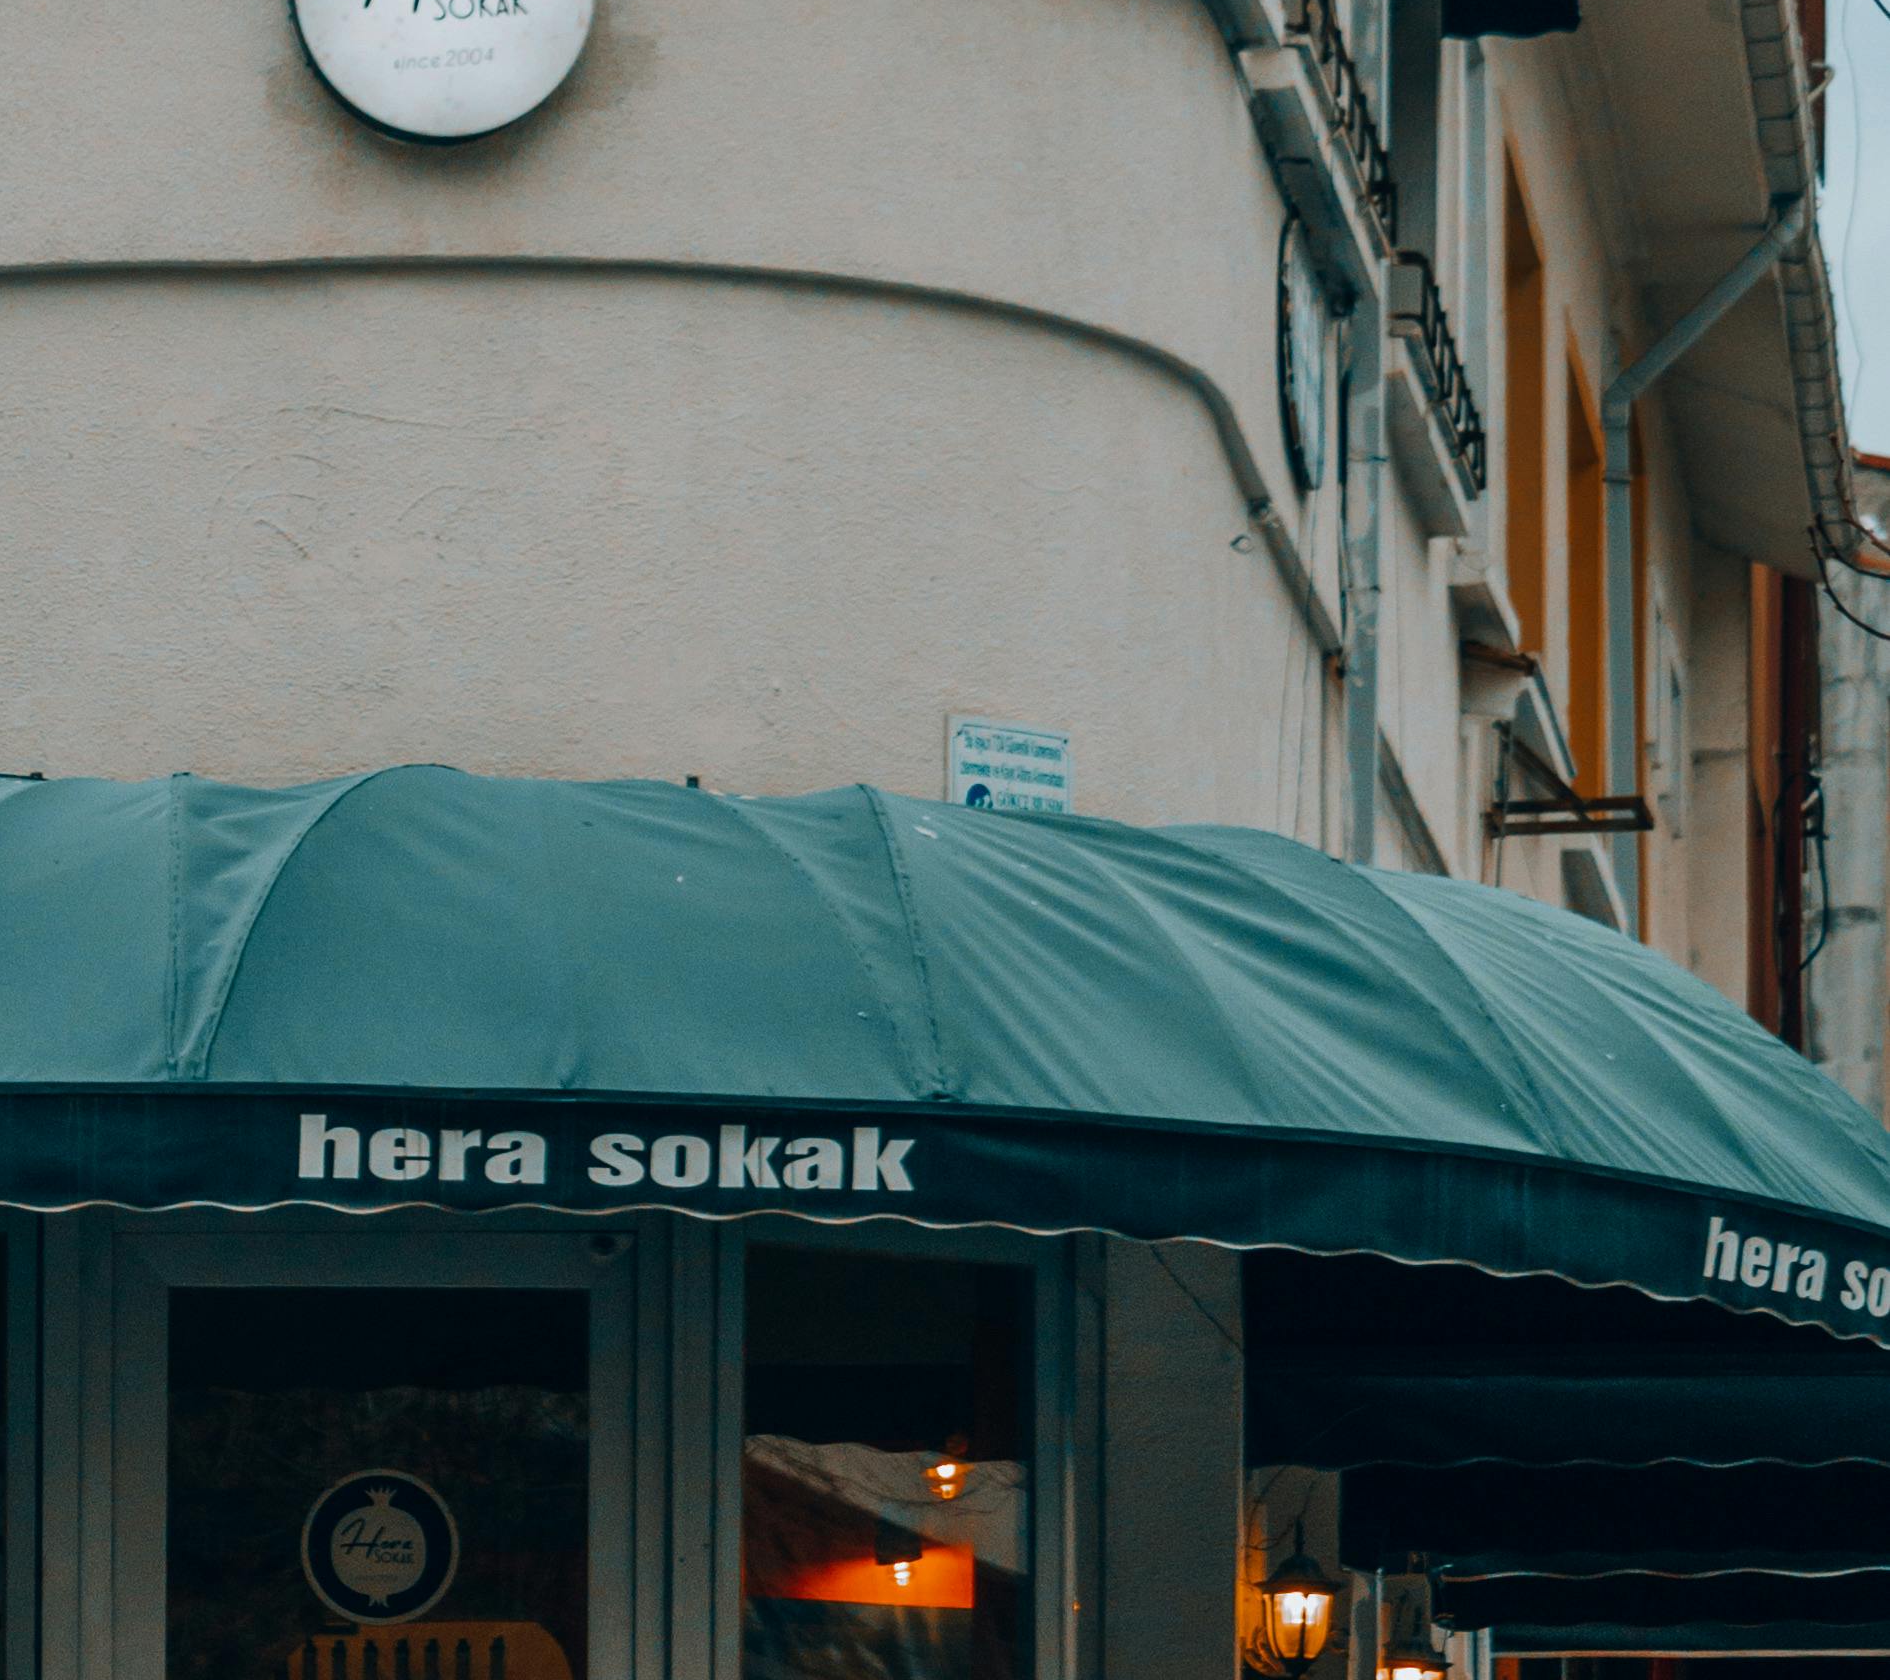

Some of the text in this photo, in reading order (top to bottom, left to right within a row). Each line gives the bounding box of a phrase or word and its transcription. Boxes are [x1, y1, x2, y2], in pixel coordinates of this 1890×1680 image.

[445, 47, 495, 68] 2004
[298, 1113, 916, 1192] hera sokak
[1702, 1215, 1828, 1302] hera
